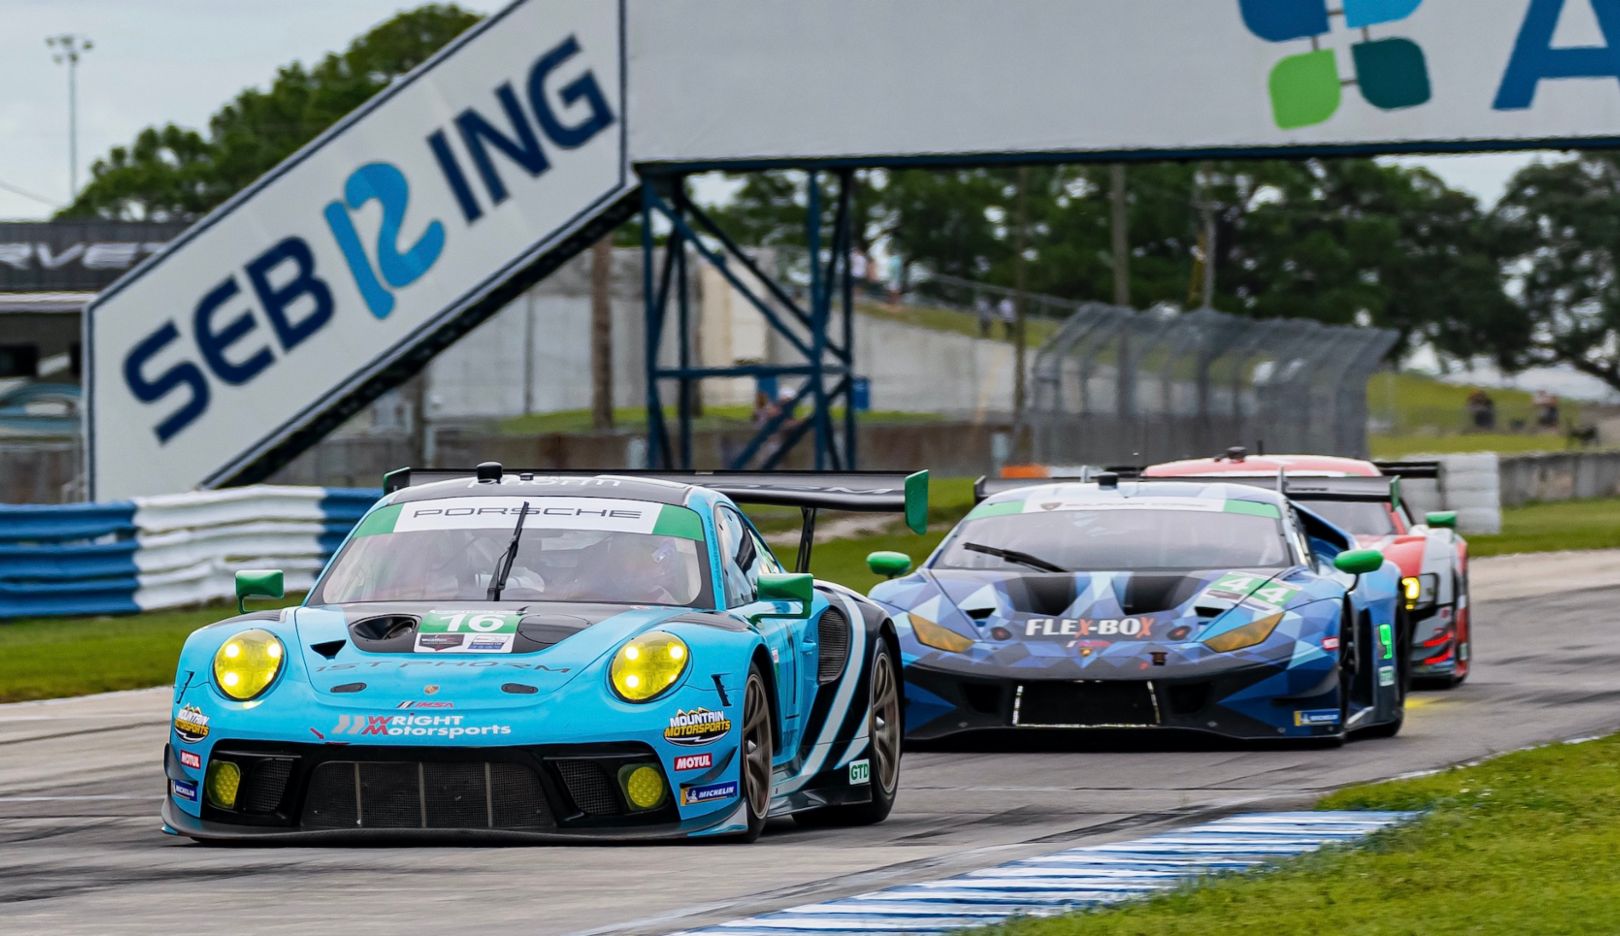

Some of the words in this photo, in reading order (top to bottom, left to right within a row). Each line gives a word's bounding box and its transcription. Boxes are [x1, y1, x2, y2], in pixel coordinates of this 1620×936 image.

[413, 506, 643, 519] PORSCHE
[1220, 578, 1290, 602] 44
[439, 613, 506, 632] 16
[1025, 617, 1154, 638] FLEX-BOX
[670, 711, 724, 728] MOUNTAIN
[361, 724, 512, 739] Motorsports
[665, 720, 731, 737] MOTORSPORTS
[676, 755, 711, 769] MOTUL
[850, 762, 869, 779] GTD
[698, 786, 734, 798] MICHELIN
